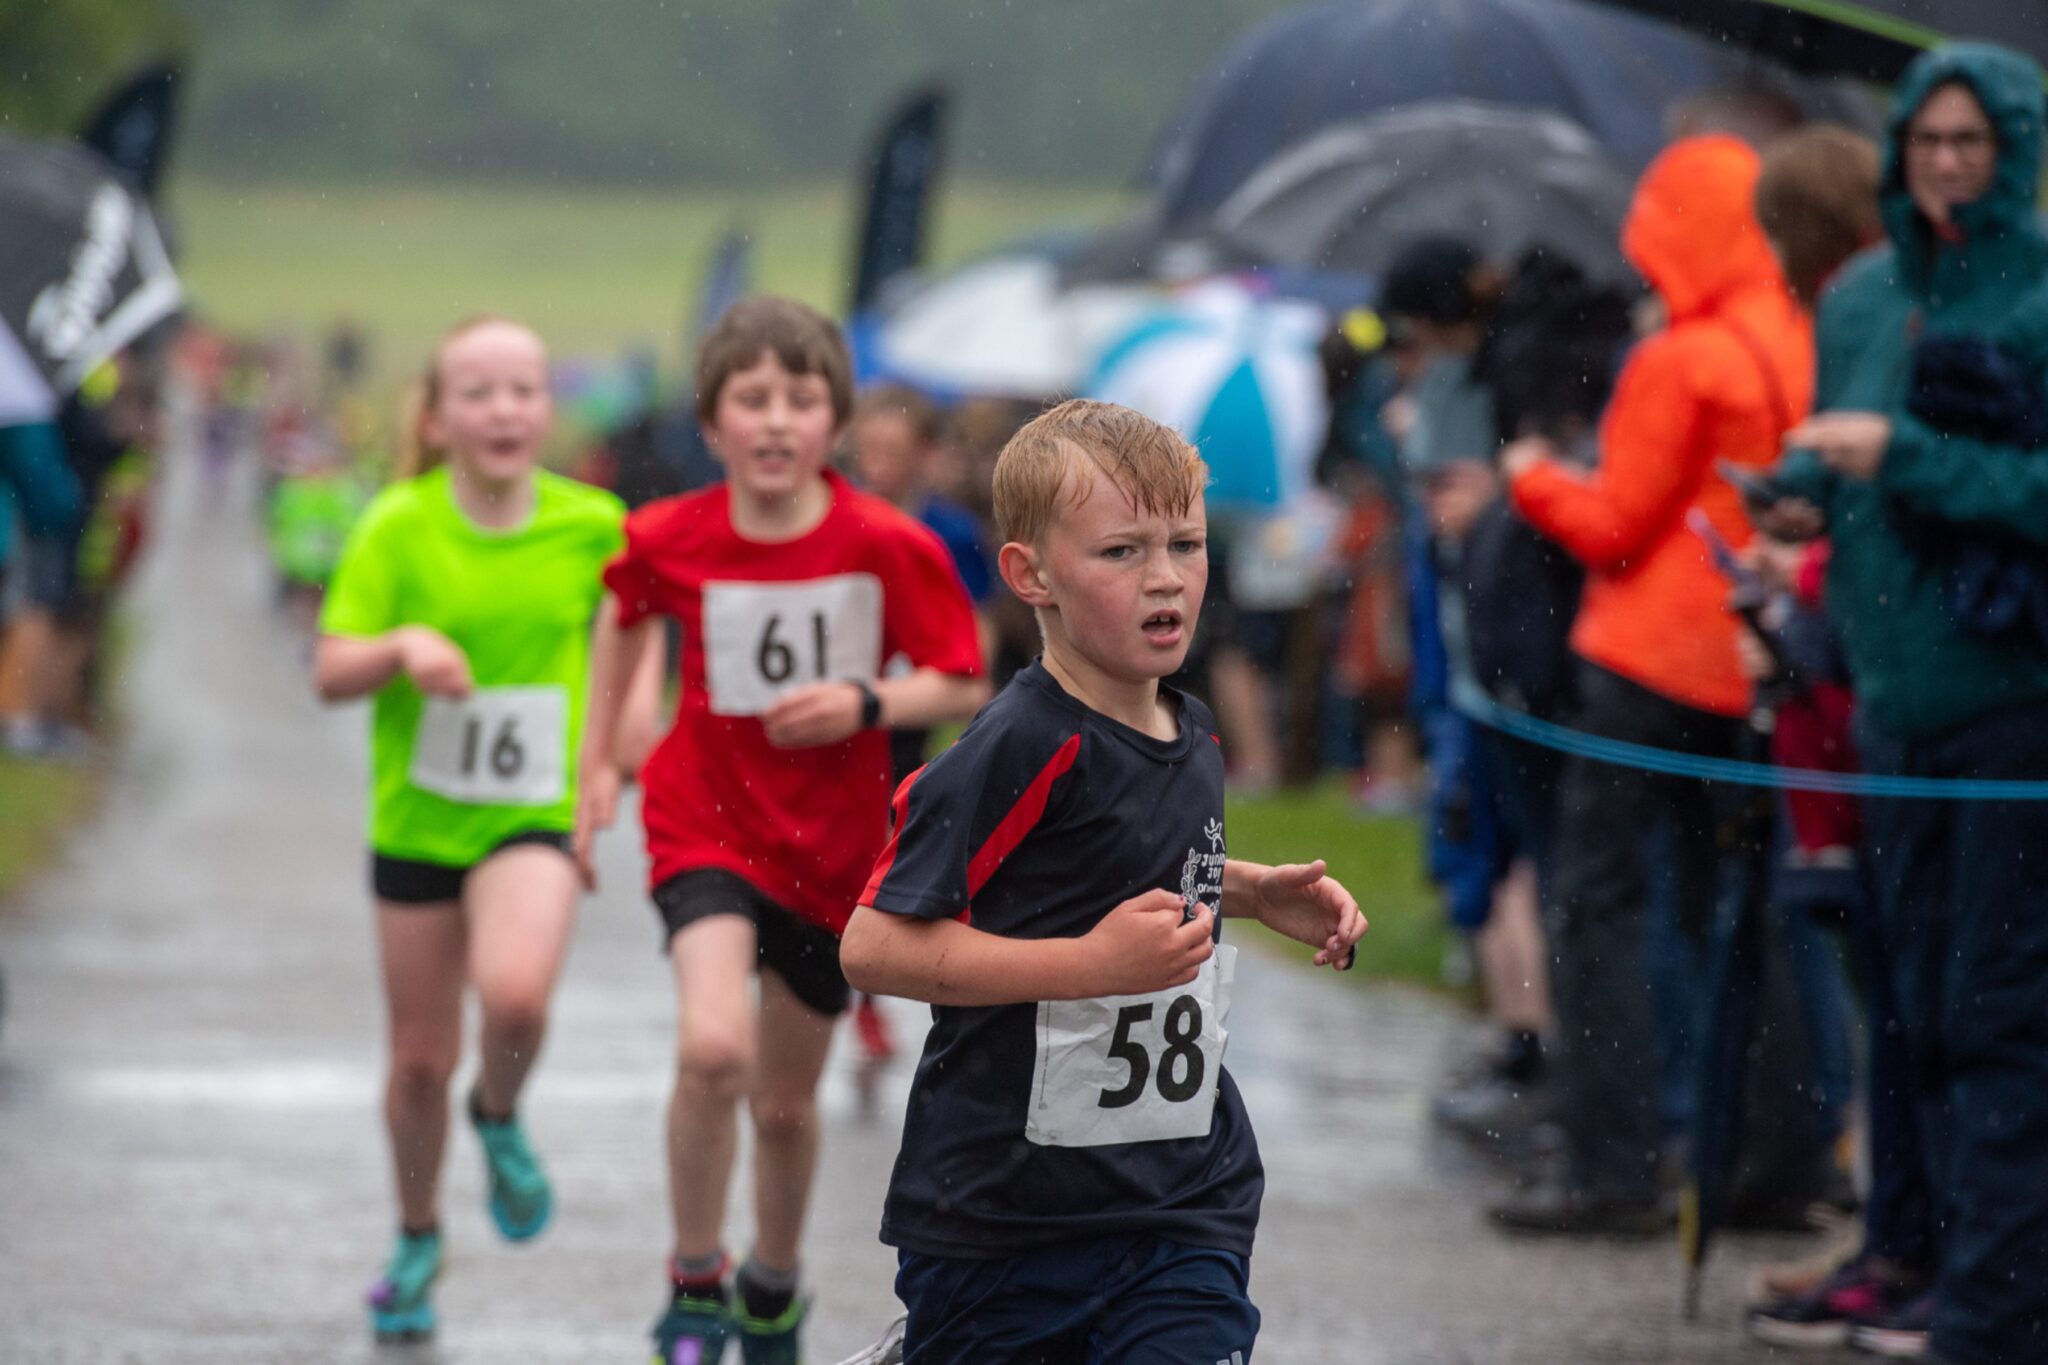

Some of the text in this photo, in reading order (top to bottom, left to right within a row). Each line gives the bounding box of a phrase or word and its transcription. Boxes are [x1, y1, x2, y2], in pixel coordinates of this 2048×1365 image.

[757, 612, 826, 683] 61
[460, 714, 525, 781] 16
[1097, 995, 1205, 1108] 58
